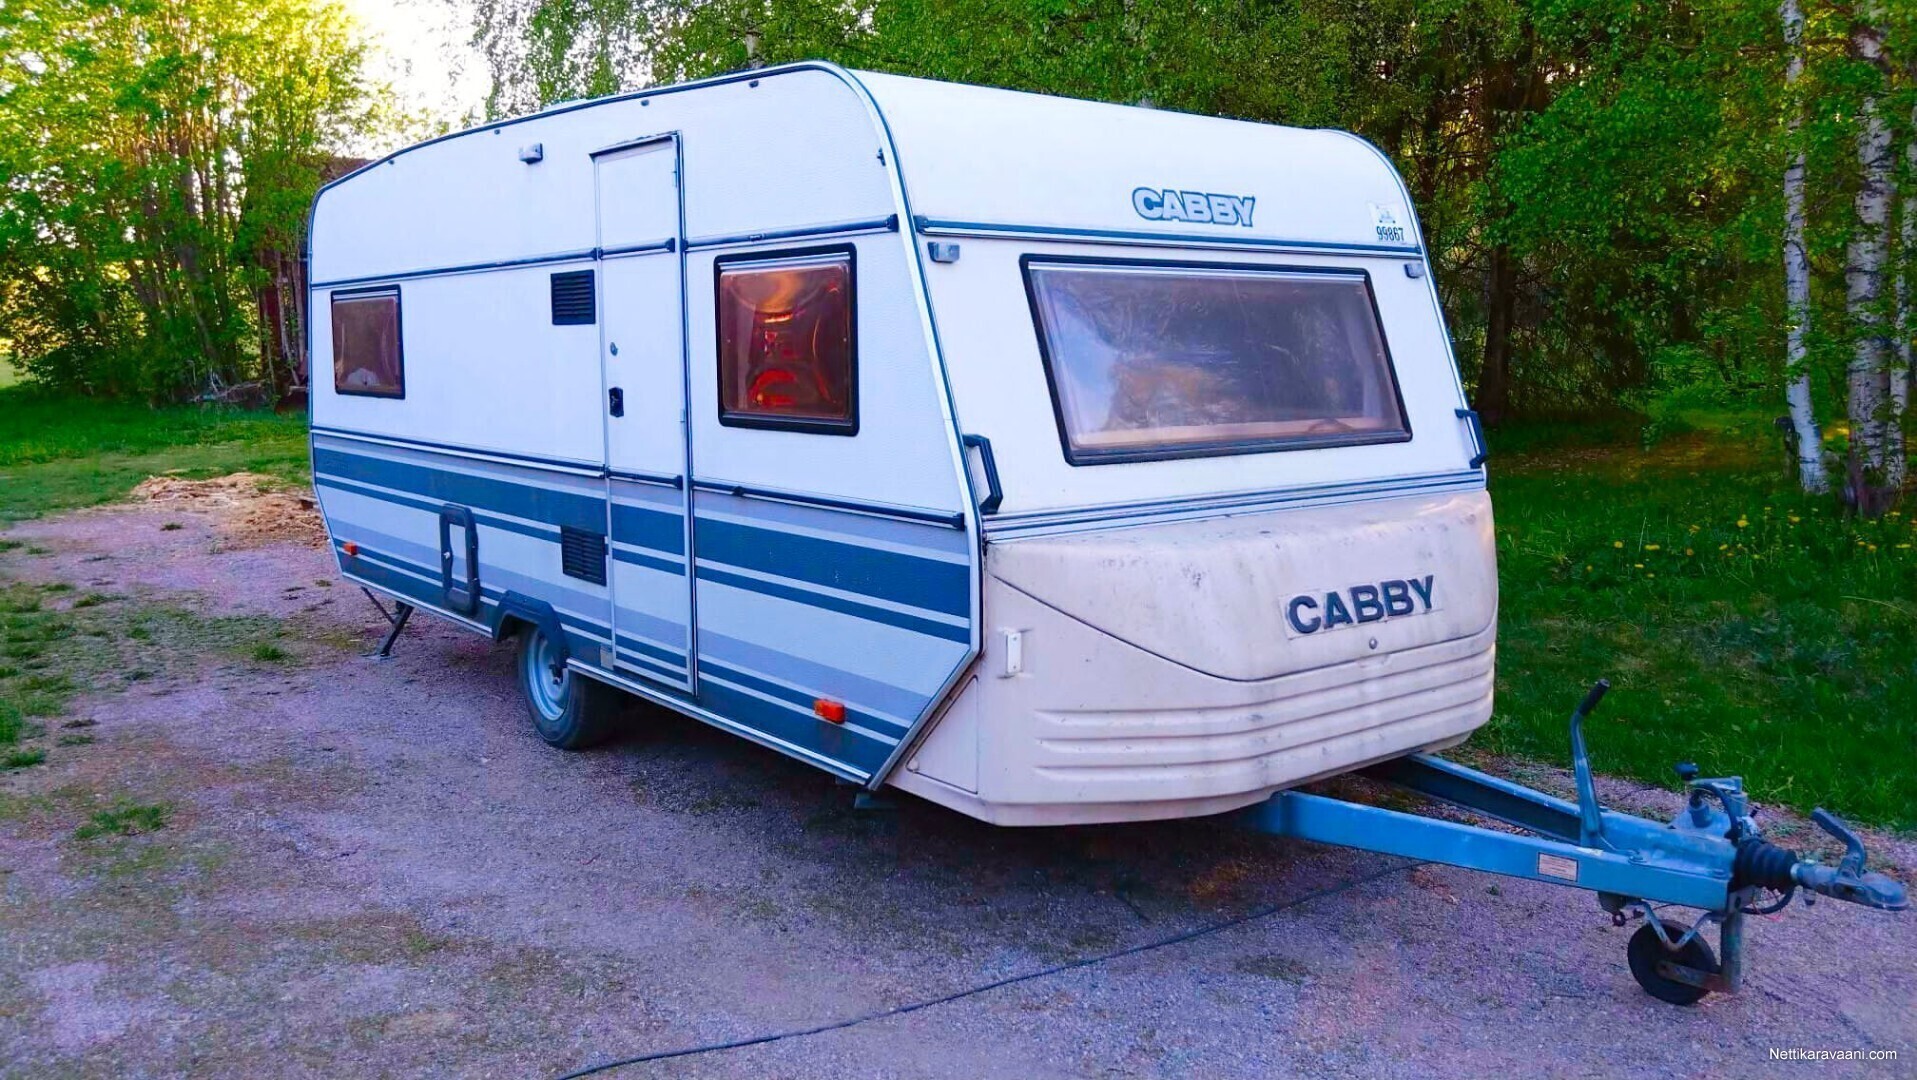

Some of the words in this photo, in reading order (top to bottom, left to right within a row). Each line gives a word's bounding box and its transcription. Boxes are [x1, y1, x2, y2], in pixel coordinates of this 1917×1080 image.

[1132, 186, 1255, 227] CABBY
[1376, 226, 1405, 241] 99867
[1288, 574, 1434, 634] CABBY
